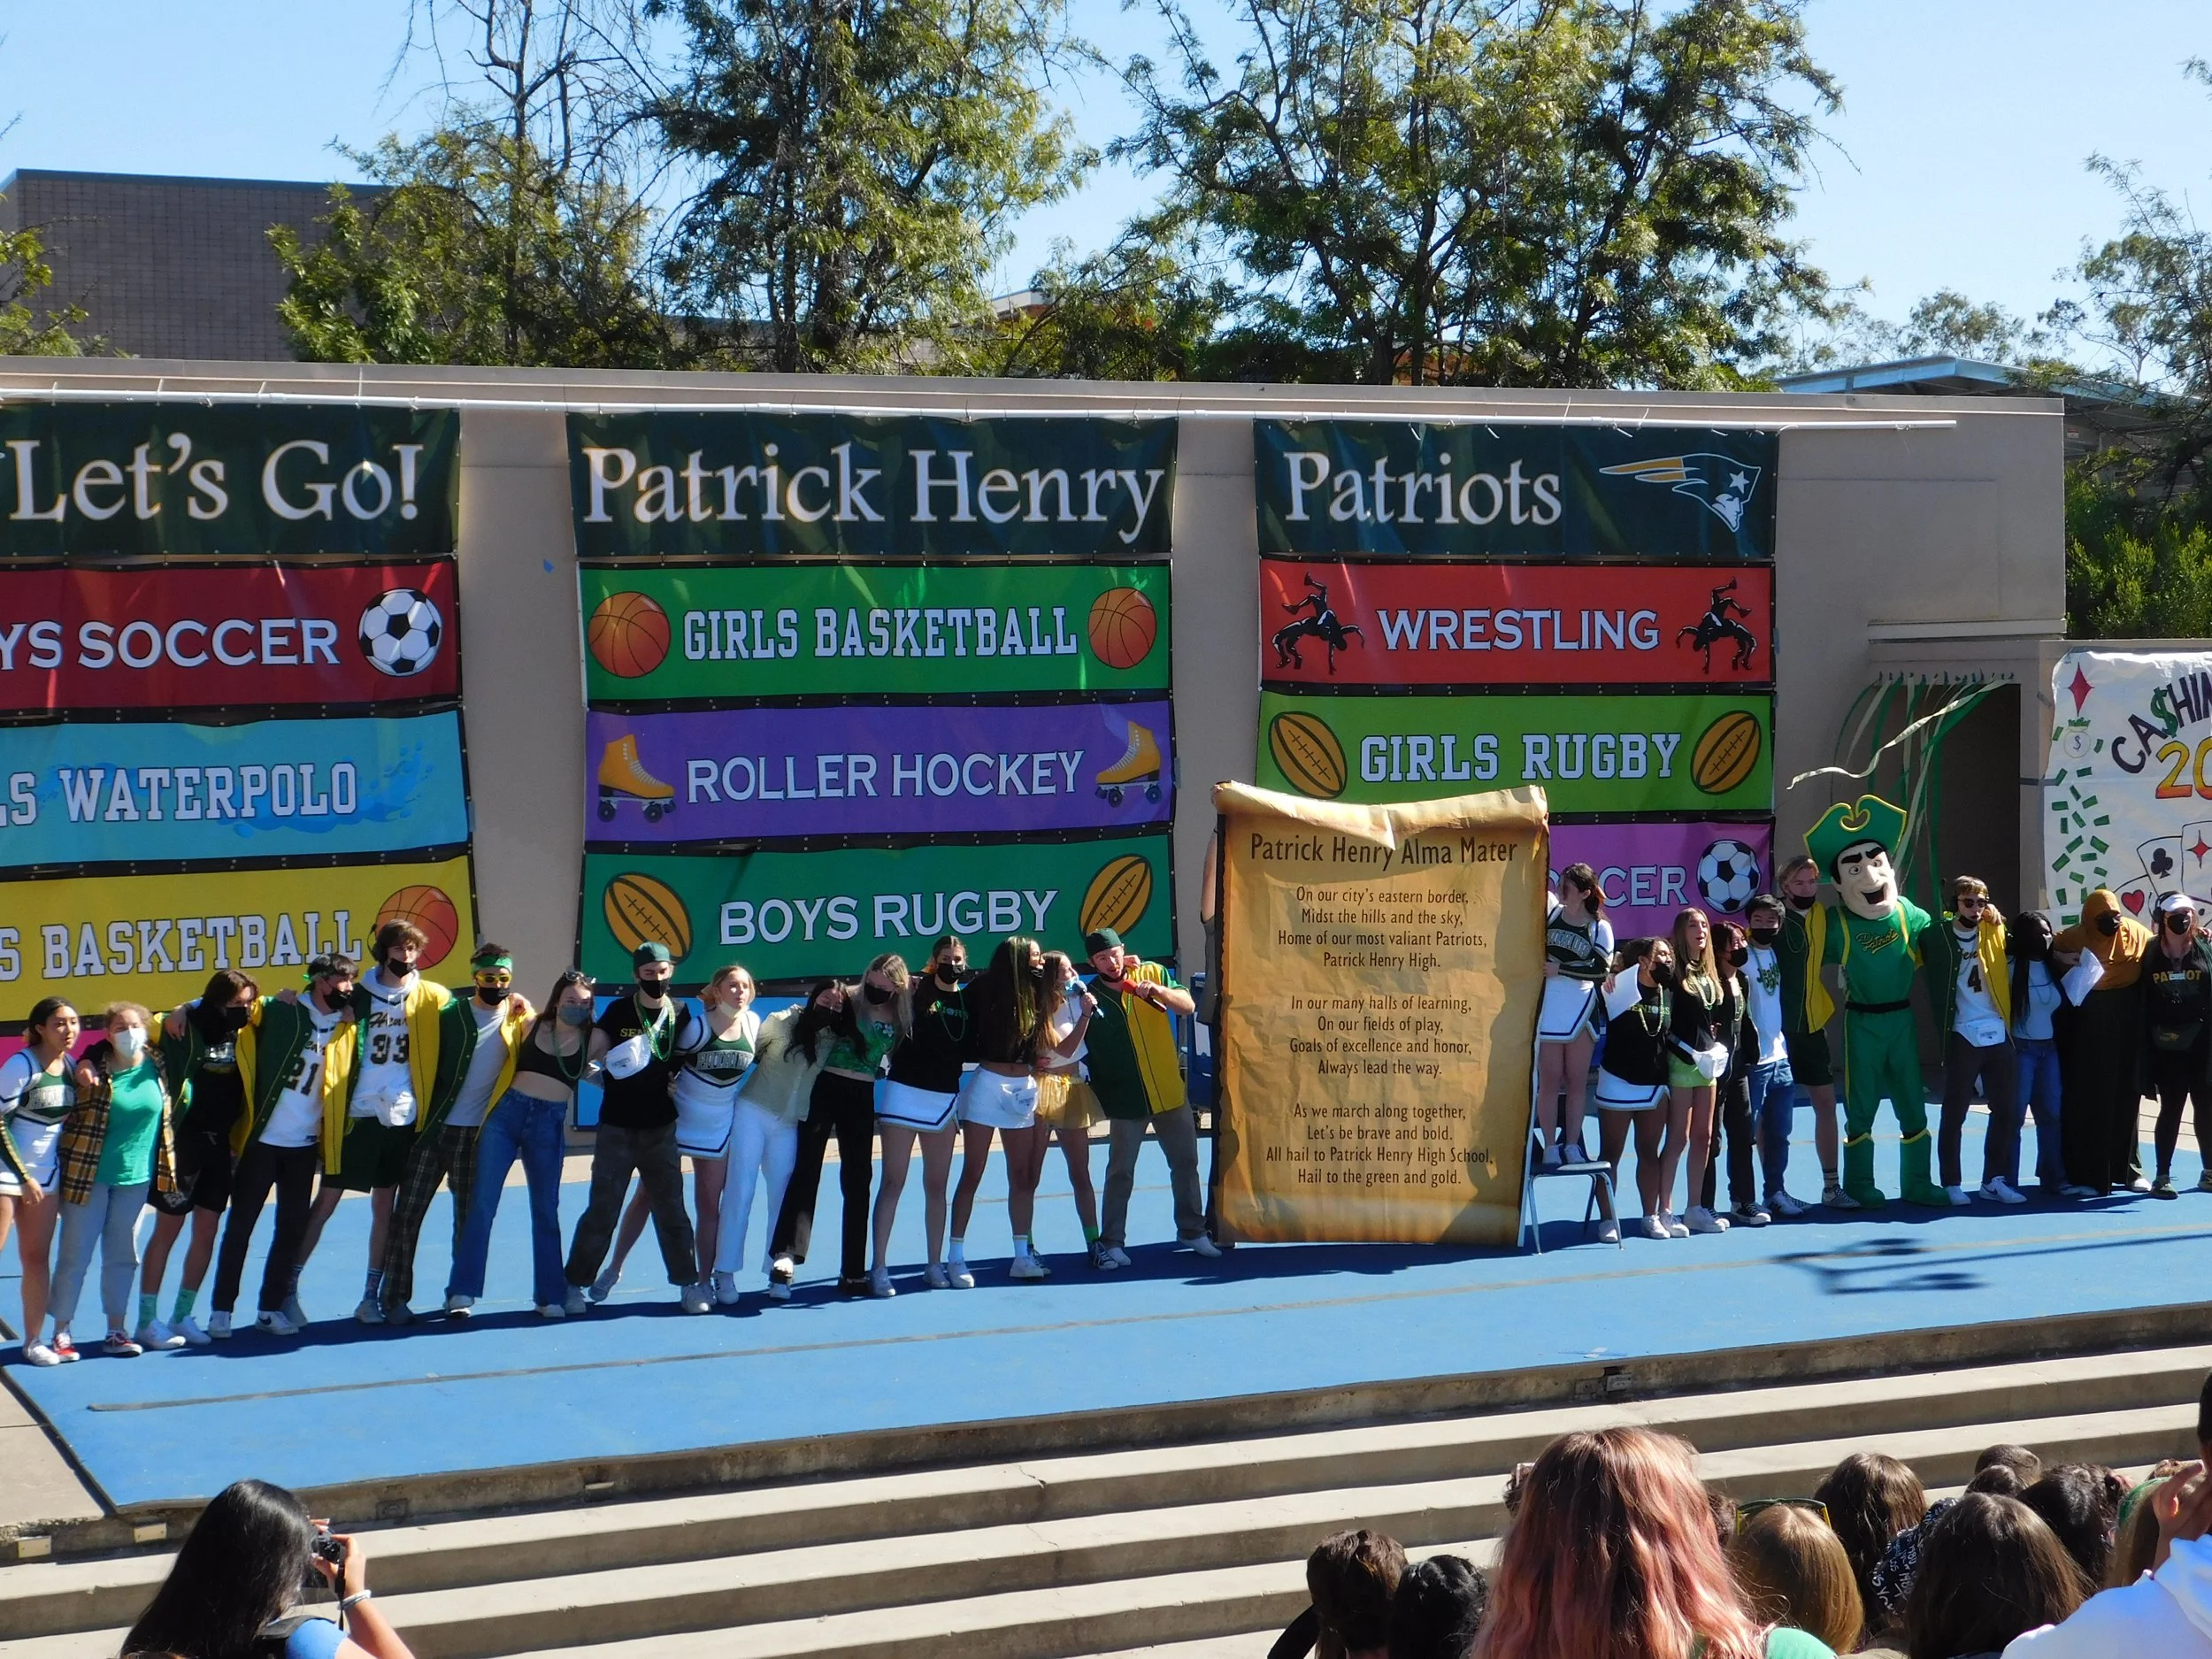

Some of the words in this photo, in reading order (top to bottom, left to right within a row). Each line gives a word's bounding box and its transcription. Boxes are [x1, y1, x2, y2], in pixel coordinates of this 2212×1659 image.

[5, 433, 228, 523] Let's
[262, 439, 425, 522] Go!
[580, 442, 886, 524] Patrick
[907, 449, 1165, 544] Henry
[1282, 450, 1563, 526] Patriots
[77, 617, 341, 670] SOCCER
[682, 608, 798, 661] GIRLS
[813, 605, 1078, 657] BASKETBALL
[1376, 608, 1660, 651] WRESTLING
[1359, 733, 1500, 783] GIRLS
[1521, 731, 1681, 781] RUGBY
[687, 754, 878, 803] ROLLER
[890, 749, 1085, 797] HOCKEY
[58, 761, 357, 823] WATERPOLO
[1251, 833, 1324, 861] Patrick
[1333, 836, 1395, 872] Henry
[1402, 840, 1453, 864] Alma
[1461, 837, 1517, 863] Mater
[1296, 887, 1313, 902] On
[1317, 890, 1338, 902] our
[1342, 888, 1374, 906] city's
[1379, 891, 1423, 903] eastern
[1427, 889, 1468, 904] border,
[718, 895, 860, 946] BOYS
[873, 889, 1059, 938] RUGBY
[1302, 909, 1333, 924] Midst
[1339, 909, 1356, 924] the
[1362, 910, 1386, 924] hills
[1391, 910, 1413, 925] and
[1418, 910, 1436, 925] the
[1440, 910, 1463, 927] sky,
[41, 910, 362, 979] BASKETBALL
[1279, 930, 1312, 945] Home
[1317, 930, 1327, 945] of
[1332, 933, 1352, 945] our
[1356, 933, 1384, 946] most
[1389, 932, 1431, 946] valiant
[1436, 932, 1486, 948] Patriots,
[1324, 952, 1365, 967] Patrick
[1370, 953, 1403, 971] Henry
[1409, 953, 1440, 972] High.
[1967, 964, 1982, 993] 4
[1292, 996, 1302, 1010] In
[1307, 998, 1328, 1010] our
[1333, 998, 1364, 1013] many
[1370, 995, 1397, 1010] halls
[1402, 995, 1414, 1010] of
[1417, 995, 1471, 1014] learning,
[1317, 1017, 1334, 1031] On
[1339, 1020, 1358, 1031] our
[1363, 1017, 1394, 1031] fields
[1399, 1017, 1411, 1032] of
[1416, 1017, 1443, 1034] play,
[370, 1033, 410, 1064] 33
[1290, 1038, 1322, 1053] Goals
[1326, 1038, 1338, 1053] of
[1342, 1039, 1402, 1053] excellence
[1407, 1039, 1429, 1053] and
[1434, 1039, 1471, 1056] honor,
[1318, 1060, 1358, 1078] Always
[1363, 1060, 1387, 1074] lead
[1393, 1060, 1411, 1074] the
[1416, 1064, 1442, 1078] way.
[1294, 1104, 1307, 1118] As
[1312, 1107, 1327, 1118] we
[1333, 1104, 1370, 1118] march
[1374, 1104, 1408, 1122] along
[1413, 1105, 1466, 1122] together,
[1307, 1125, 1334, 1140] Let's
[1340, 1125, 1353, 1140] be
[1357, 1125, 1391, 1141] brave
[1395, 1126, 1417, 1141] and
[1423, 1126, 1453, 1141] bold.
[1266, 1148, 1281, 1162] All
[1286, 1147, 1309, 1162] hail
[1314, 1150, 1325, 1162] to
[1330, 1147, 1371, 1162] Patrick
[1377, 1148, 1413, 1165] Henry
[1417, 1148, 1446, 1166] High
[1298, 1169, 1322, 1183] Hail
[1327, 1171, 1339, 1183] to
[1343, 1169, 1362, 1184] the
[1366, 1173, 1399, 1187] green
[1404, 1170, 1426, 1185] and
[1431, 1170, 1461, 1187] gold.
